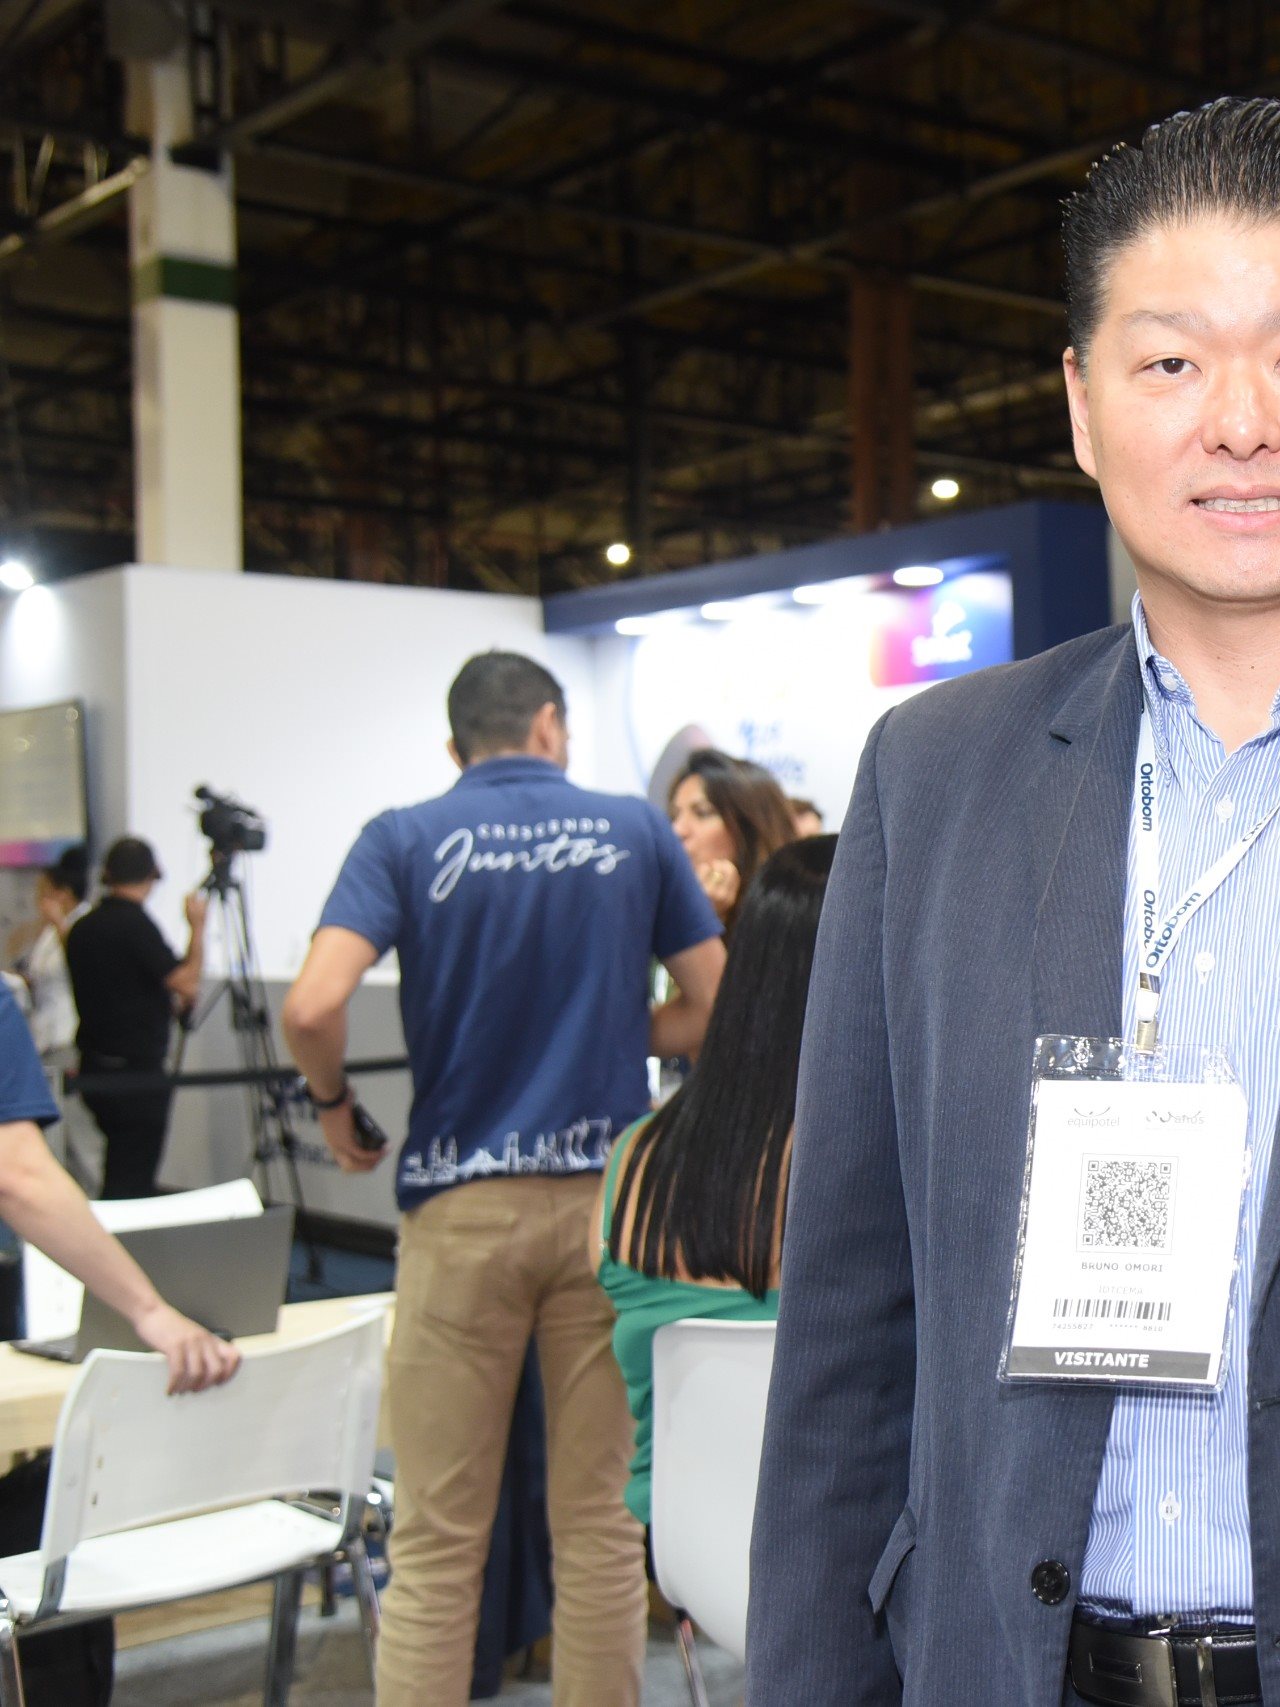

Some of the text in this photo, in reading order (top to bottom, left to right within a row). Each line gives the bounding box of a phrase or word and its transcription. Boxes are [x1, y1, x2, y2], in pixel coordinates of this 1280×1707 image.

[1140, 762, 1155, 832] Ortobom
[428, 828, 632, 903] Juntos
[1143, 889, 1156, 949] Ortob
[1146, 891, 1201, 968] Ortobom
[1067, 1116, 1120, 1129] equipotel
[1081, 1261, 1163, 1273] BRUNO OMORI
[1054, 1351, 1150, 1368] VISITANTE
